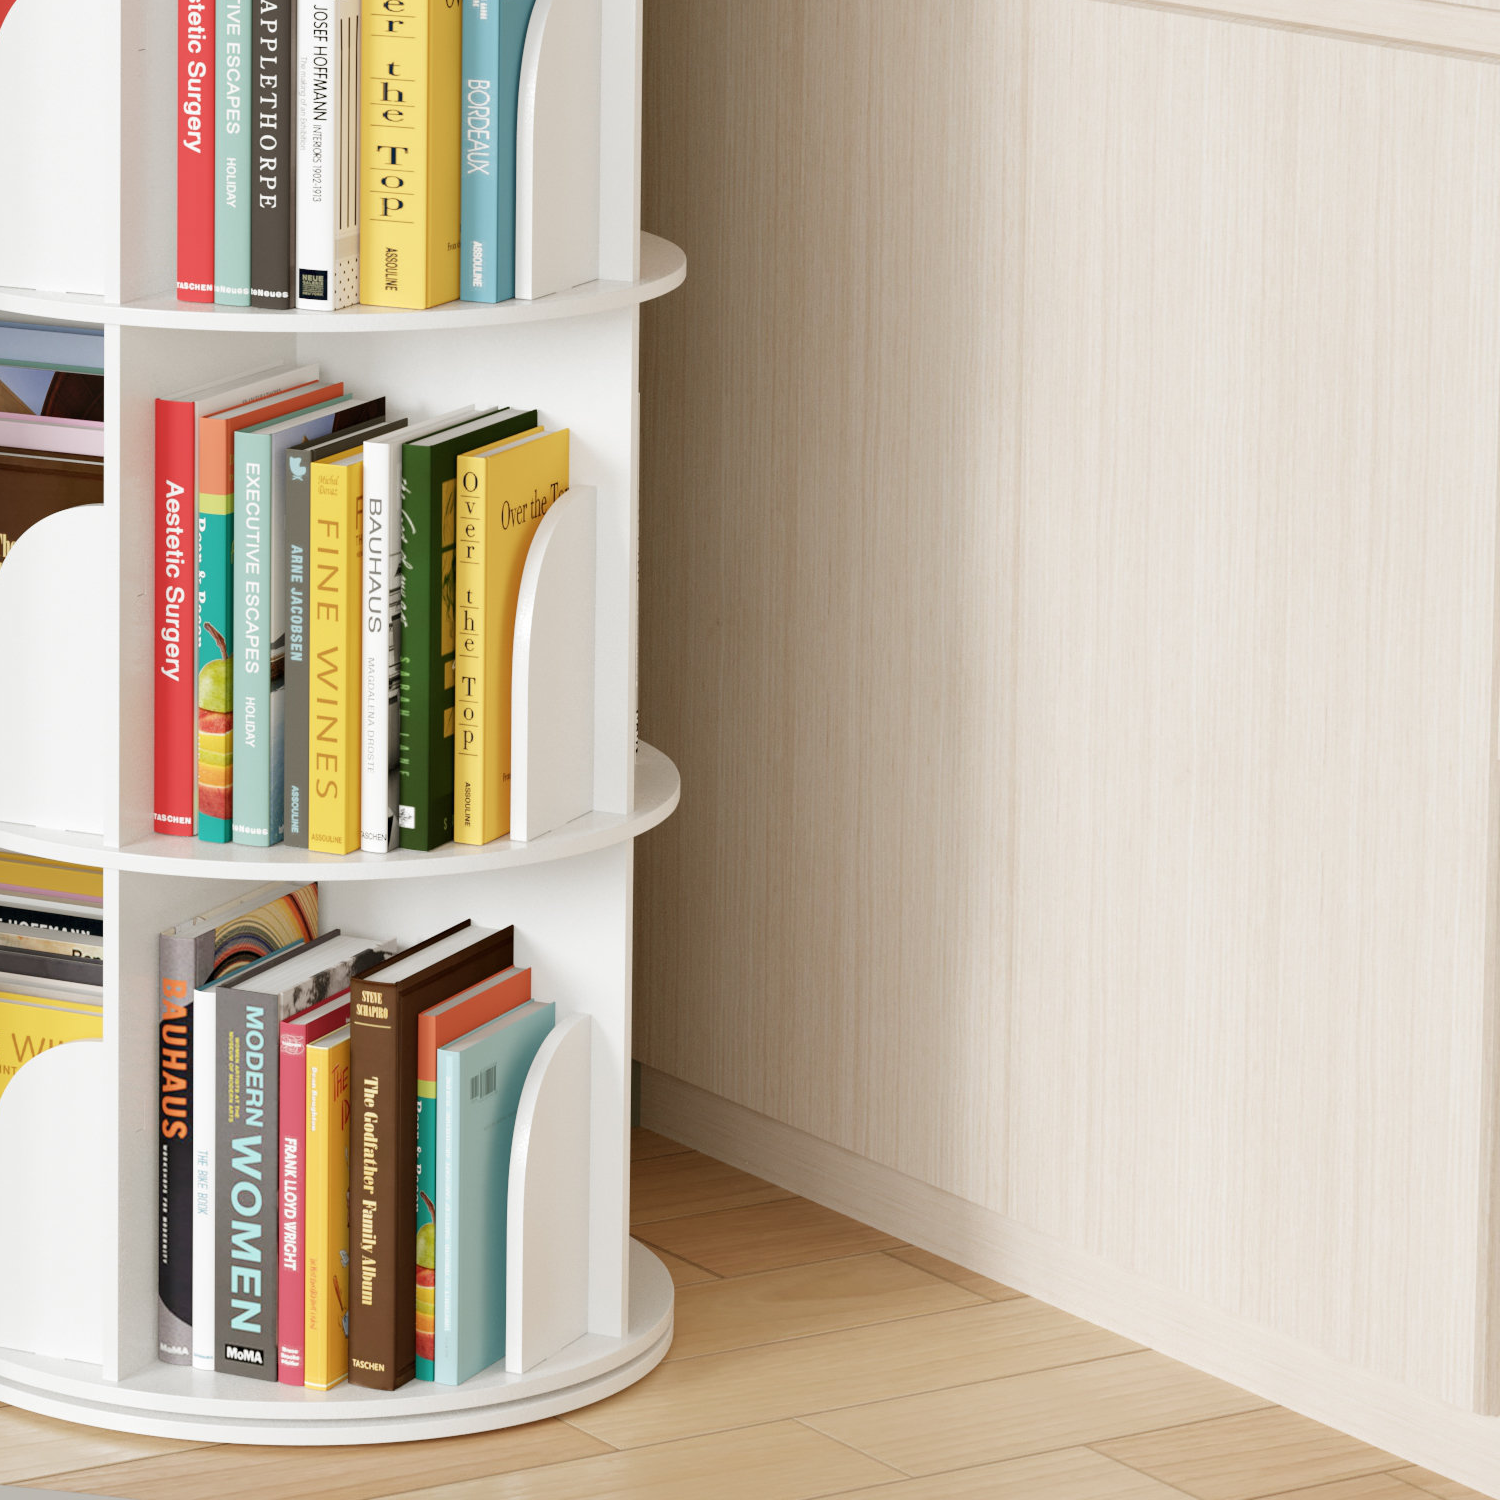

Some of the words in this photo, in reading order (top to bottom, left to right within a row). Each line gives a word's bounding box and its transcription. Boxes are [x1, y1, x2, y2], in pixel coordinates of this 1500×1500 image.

[184, 62, 206, 154] Surgery
[226, 42, 240, 134] ESCAPES
[467, 79, 490, 176] BORDEAUX
[226, 158, 236, 208] HOLIDAY
[385, 248, 398, 292] ASSOULINE
[165, 480, 185, 578] Aestetic
[246, 462, 260, 574] EXECUTIVE
[462, 472, 479, 559] Over
[290, 544, 303, 583] ARNE
[317, 519, 339, 622] FINE
[368, 498, 382, 633] BAUHAUS
[161, 586, 185, 682] Surgery
[245, 582, 260, 674] ESCAPES
[290, 588, 303, 662] JACOBSEN
[464, 589, 476, 652] the
[244, 697, 256, 748] HOLIDAY
[316, 646, 338, 800] WINES
[462, 676, 476, 750] Top
[291, 786, 300, 834] ASSOULINE
[356, 1004, 388, 1019] SCHAPIRO
[362, 990, 382, 1004] STEVE
[162, 977, 188, 1140] BAUHAUS
[246, 1006, 264, 1128] MODERN
[364, 1076, 378, 1108] The
[284, 1137, 298, 1178] FRANK
[362, 1111, 378, 1194] Godfather
[230, 1135, 262, 1334] WOMEN
[284, 1180, 298, 1219] LLOYD
[360, 1200, 377, 1254] Family
[284, 1222, 298, 1271] WRIGHT
[362, 1255, 376, 1306] Album
[226, 1346, 263, 1364] MoMA
[352, 1358, 384, 1372] TASCHEN
